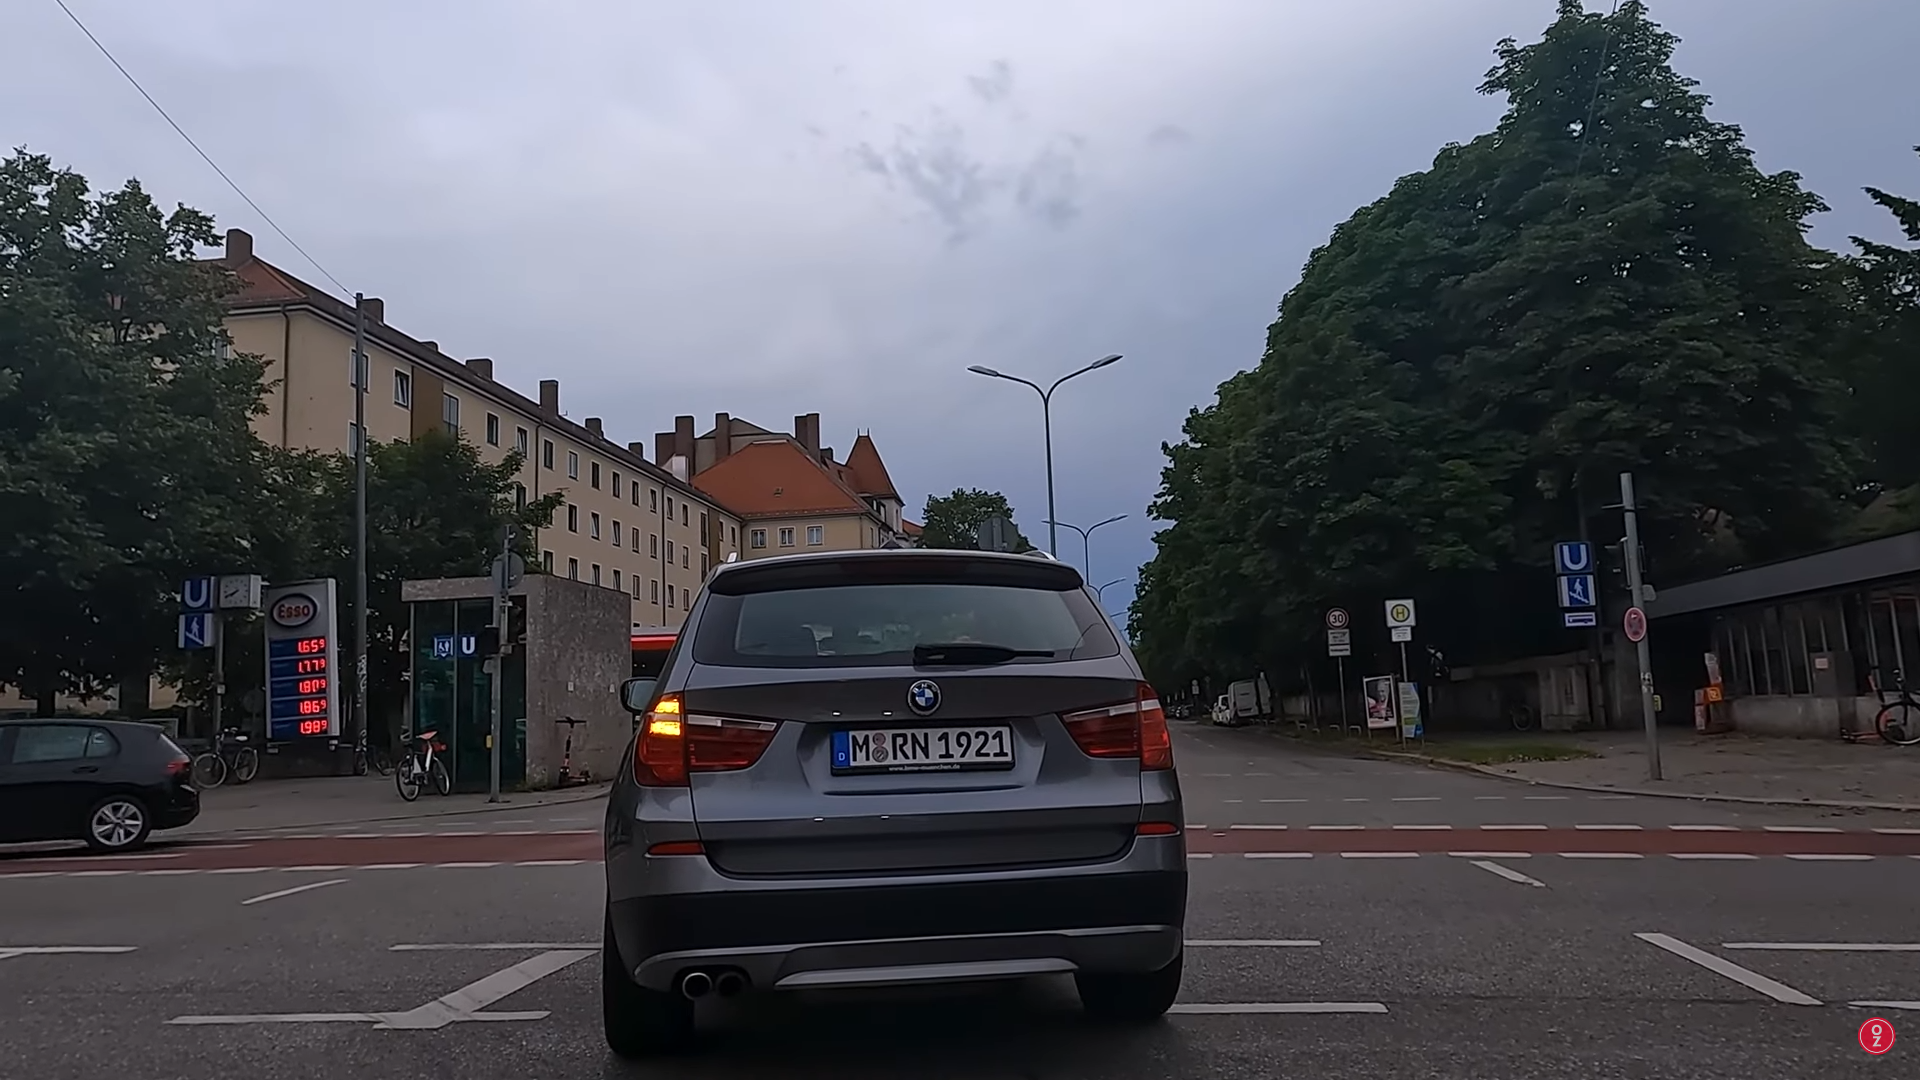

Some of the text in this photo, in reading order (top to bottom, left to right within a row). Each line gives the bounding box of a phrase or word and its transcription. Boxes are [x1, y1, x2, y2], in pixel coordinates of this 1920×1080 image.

[1562, 544, 1588, 571] U
[184, 579, 208, 608] U
[278, 603, 310, 618] Esso
[1331, 613, 1343, 624] 30
[461, 636, 476, 655] U
[838, 730, 1008, 762] D M RN 1921
